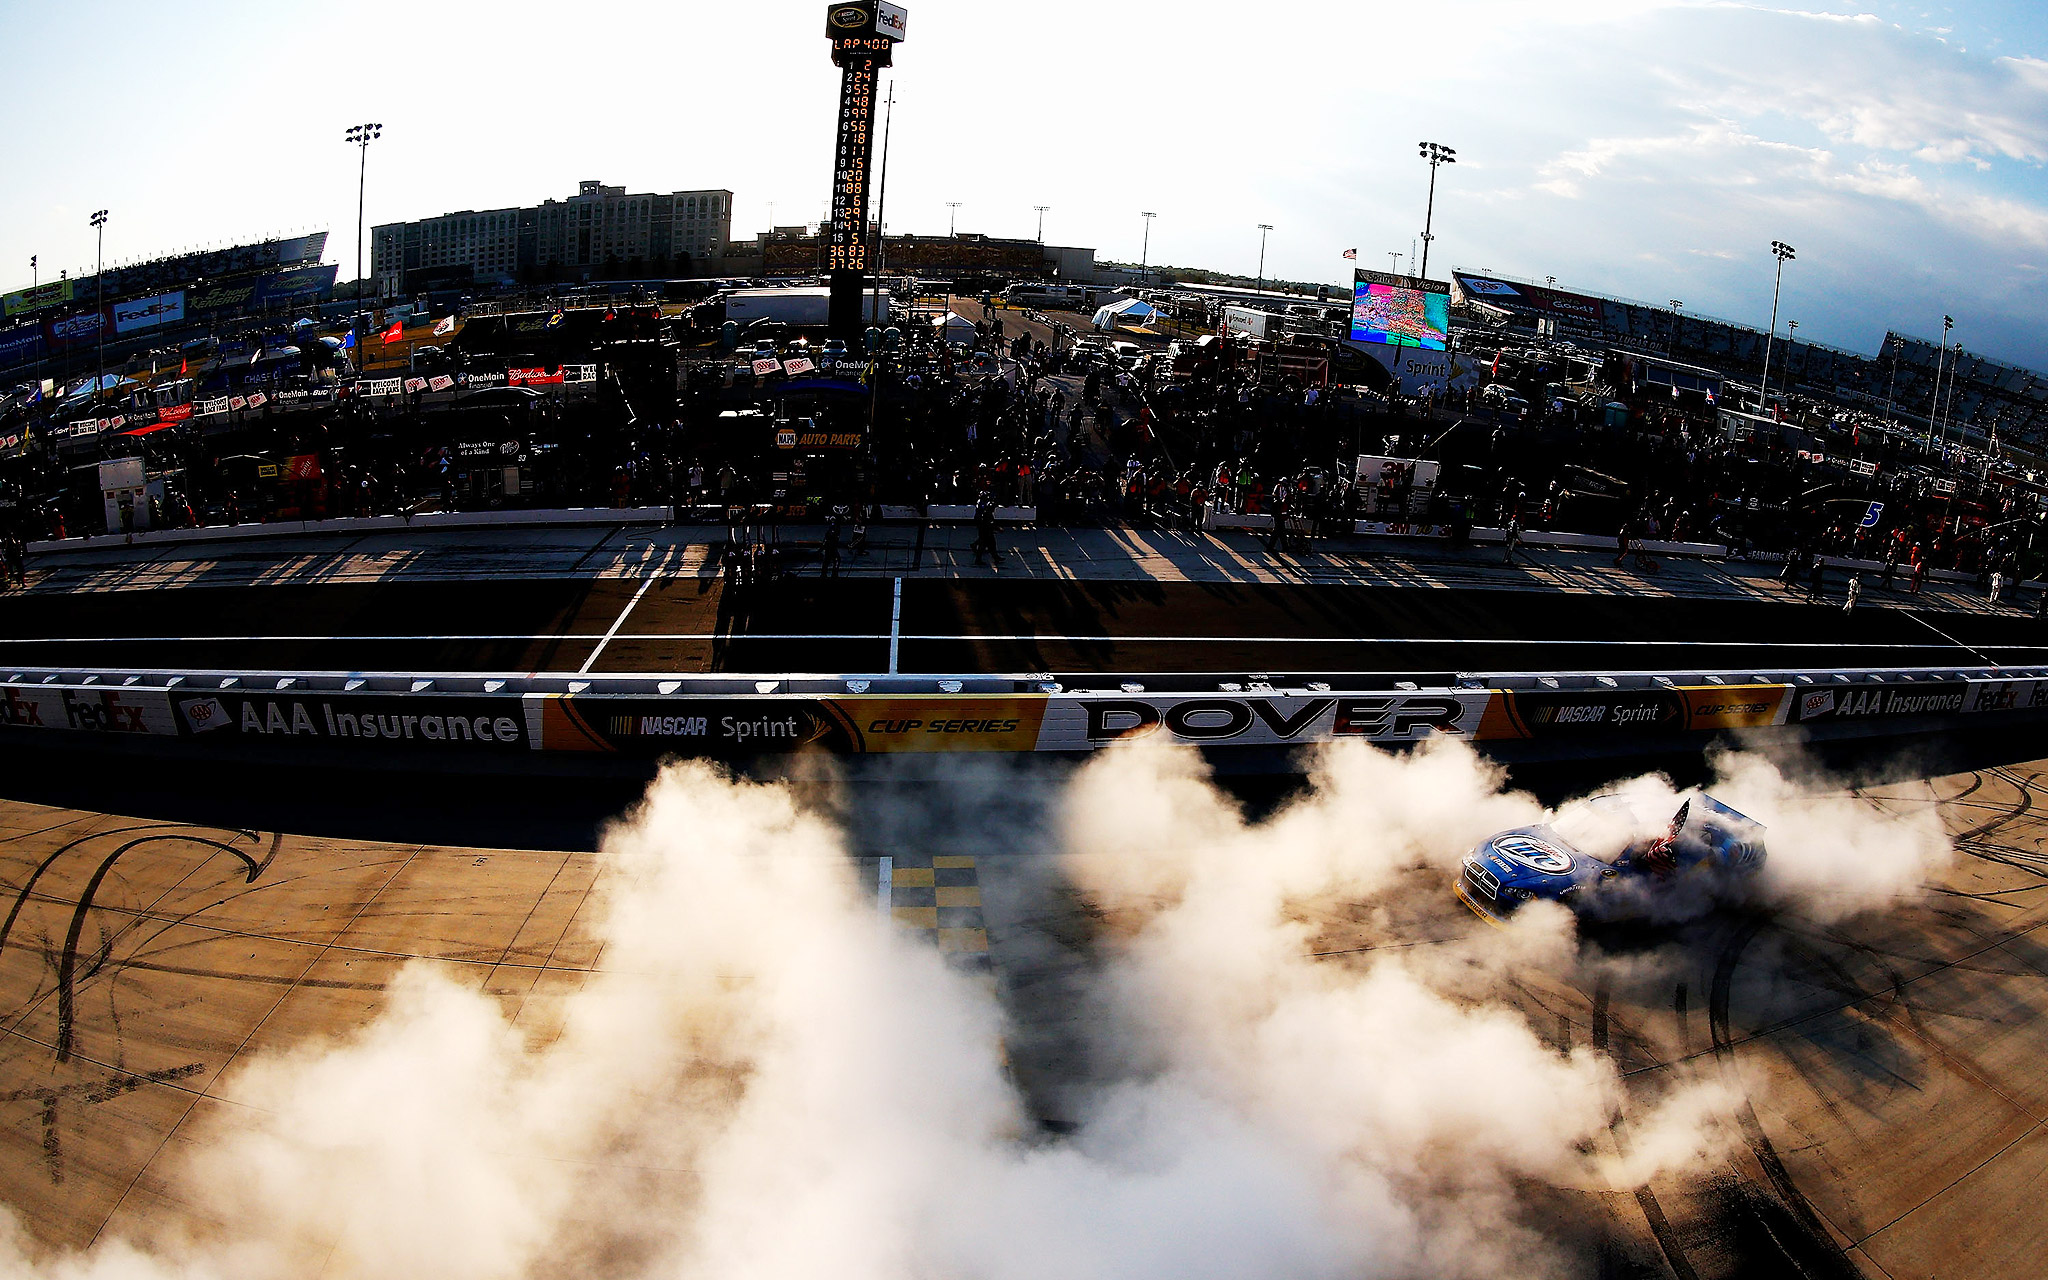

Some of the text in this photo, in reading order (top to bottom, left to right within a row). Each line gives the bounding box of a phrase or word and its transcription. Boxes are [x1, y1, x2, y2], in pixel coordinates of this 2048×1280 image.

[878, 9, 904, 31] FedEx
[834, 38, 889, 50] LAP 400
[848, 59, 872, 71] 1 2
[847, 71, 871, 83] 2 24
[845, 84, 870, 95] 3 55
[844, 95, 869, 108] 4 48
[843, 107, 868, 119] 5 99
[842, 120, 866, 132] 6 56
[842, 132, 866, 144] 7 18
[840, 145, 865, 156] 8 11
[840, 157, 864, 169] 9 15
[836, 169, 863, 182] 10 20
[835, 182, 862, 194] 11 88
[834, 195, 861, 207] 12 6
[833, 207, 860, 219] 13 29
[833, 220, 860, 231] 14 47
[832, 232, 859, 245] 15 5
[829, 245, 865, 257] 36 83
[829, 258, 864, 270] 37 26
[1368, 272, 1447, 292] Sprint Vision
[208, 285, 254, 300] 5-hour
[200, 293, 250, 309] ENERGY
[117, 301, 180, 323] FedEx
[1552, 301, 1596, 315] Good!
[1618, 335, 1664, 351] LUCAS OIL
[1405, 359, 1446, 378] Sprint
[372, 379, 400, 388] WELCOME
[468, 372, 505, 383] OneMain
[279, 389, 309, 399] OneMain
[372, 387, 385, 395] RACE
[458, 441, 481, 449] Always
[778, 433, 862, 446] NAPA AUTO PARTS
[1861, 500, 1885, 528] 5
[1386, 523, 1410, 534] 3M
[1751, 550, 1785, 561] FARMERS
[1972, 681, 2019, 711] FedEx
[60, 687, 150, 733] FedEx
[1694, 702, 1772, 716] CUP SERIES
[1835, 690, 1963, 717] AAA Insurance
[190, 704, 211, 720] AAA
[1554, 705, 1607, 724] NASCAR
[1611, 703, 1659, 726] Sprint
[241, 701, 519, 742] AAA Insurance
[866, 717, 1021, 735] CUP SERIES
[1077, 697, 1467, 742] DOVER
[639, 716, 708, 737] NASCAR
[721, 715, 798, 744] Sprint
[1460, 892, 1488, 919] CHARGER
